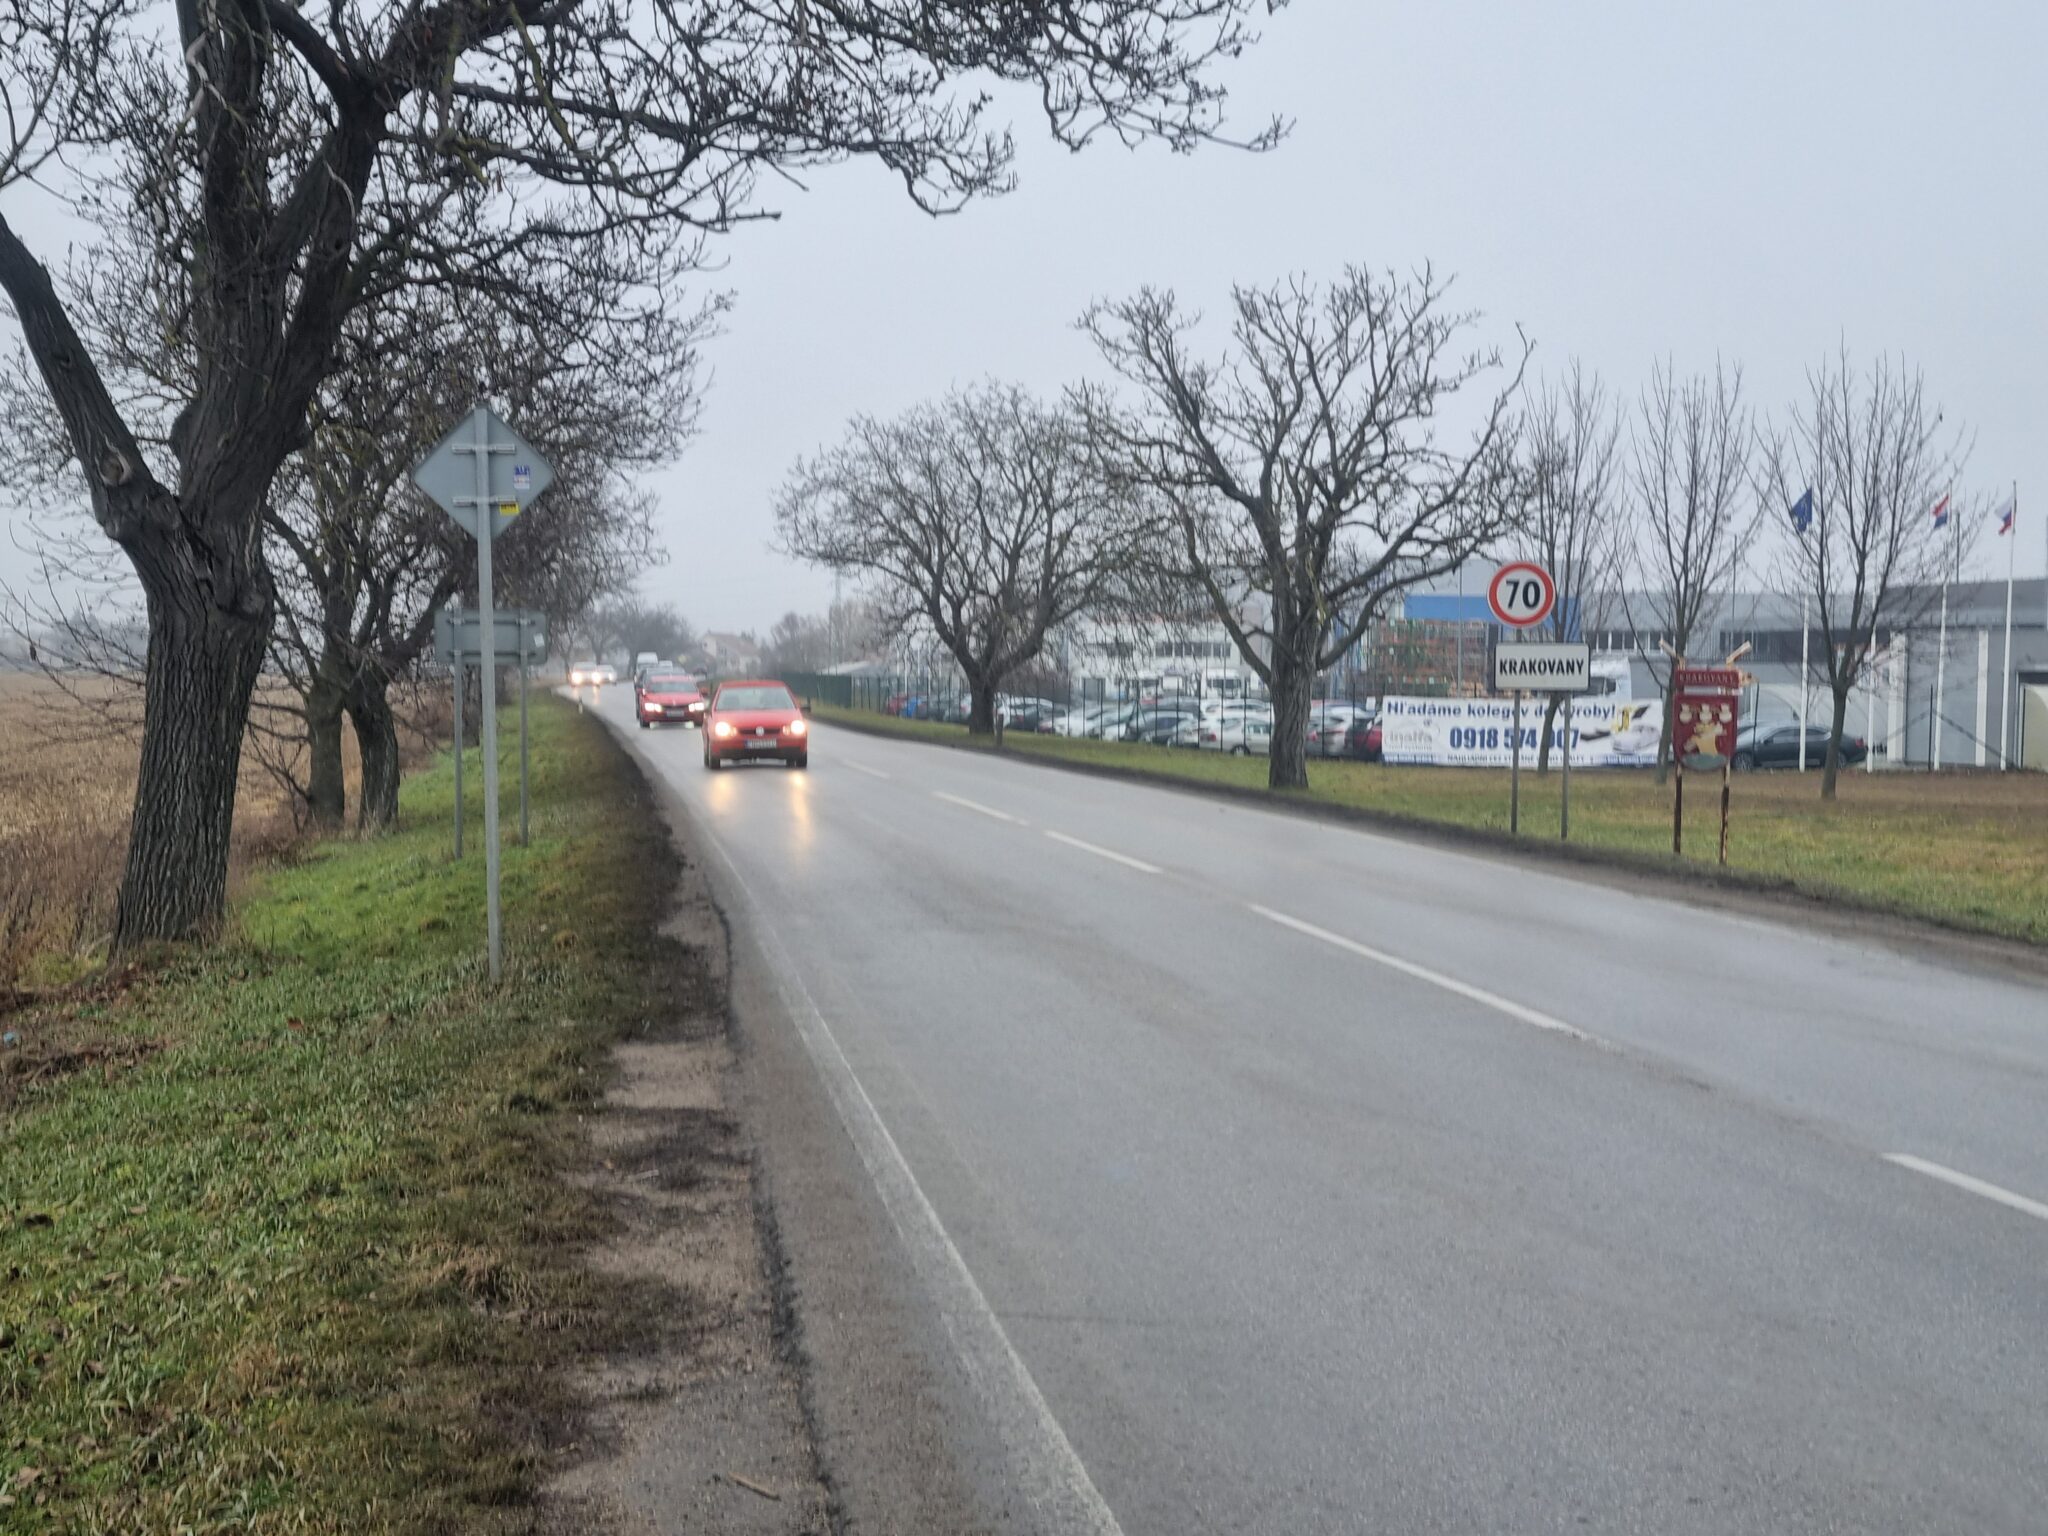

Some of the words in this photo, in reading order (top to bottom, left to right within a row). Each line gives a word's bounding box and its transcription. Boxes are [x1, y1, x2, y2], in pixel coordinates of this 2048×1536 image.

[1506, 579, 1541, 609] 70
[1499, 658, 1584, 676] KRAKOVANY
[1468, 703, 1530, 720] kolegv
[1449, 727, 1499, 749] 0918
[1503, 727, 1538, 749] 574
